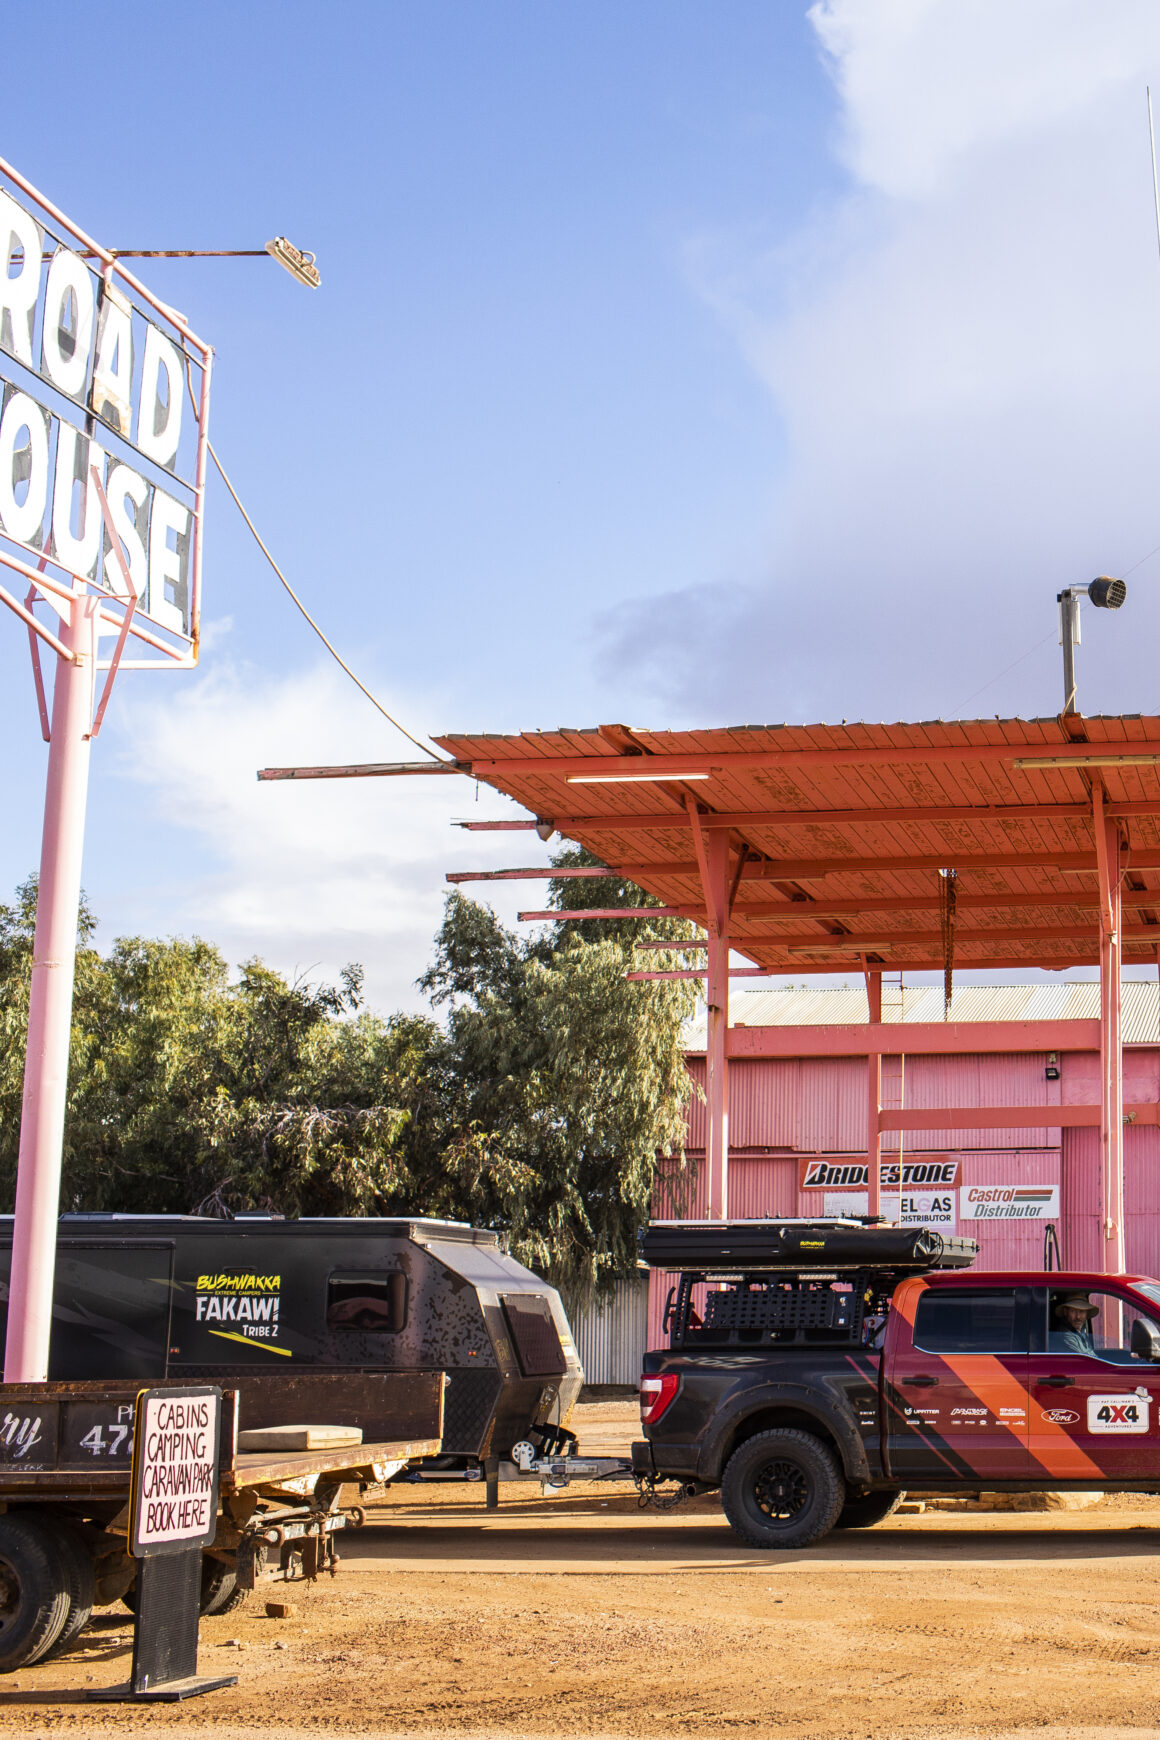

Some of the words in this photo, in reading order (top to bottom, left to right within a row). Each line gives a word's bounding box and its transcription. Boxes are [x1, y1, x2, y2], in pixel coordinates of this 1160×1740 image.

[0, 186, 184, 466] ROAD
[0, 391, 191, 635] OUSE
[804, 1162, 956, 1186] BRIDESTONE
[901, 1197, 952, 1212] ELGAS
[968, 1188, 1015, 1203] Castrol
[901, 1214, 952, 1222] DISTRIBUTOR
[974, 1204, 1043, 1218] Distributor
[196, 1274, 280, 1291] BUSHWAKKA
[272, 1325, 279, 1337] 2
[158, 1403, 208, 1430] CABINS
[1049, 1409, 1072, 1421] Ford
[1097, 1405, 1139, 1423] 4X4
[148, 1432, 206, 1462] CAMPING
[143, 1463, 192, 1499] CARAVAN
[191, 1462, 215, 1494] PARK
[146, 1501, 176, 1533] BOOK
[177, 1499, 208, 1529] HERE
